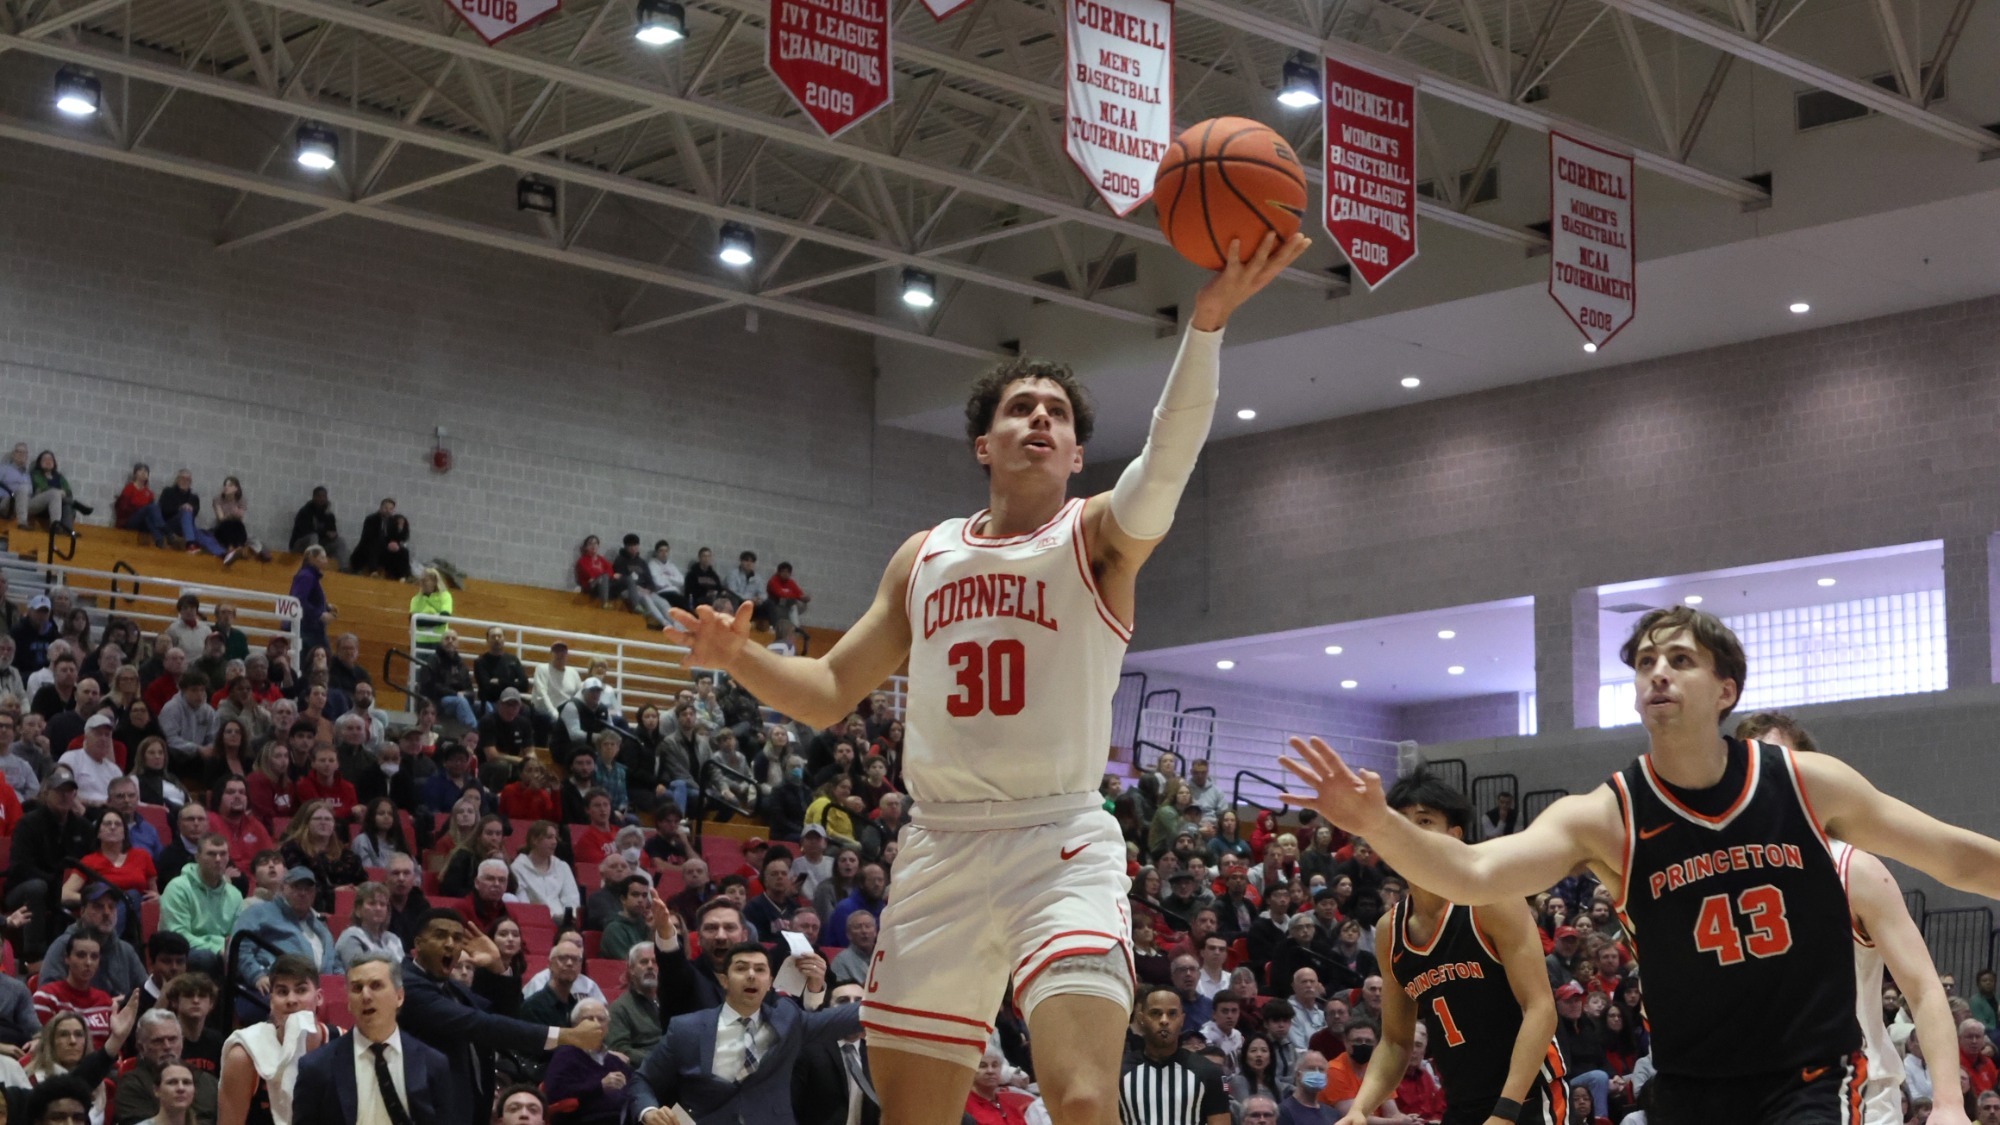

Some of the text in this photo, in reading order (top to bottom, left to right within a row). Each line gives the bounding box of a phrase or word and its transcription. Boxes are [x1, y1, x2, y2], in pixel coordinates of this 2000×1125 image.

[781, 2, 879, 49] IVY LEAGUE
[1075, 0, 1165, 50] CORNELL
[779, 29, 881, 87] CHAMPIONS
[1099, 48, 1140, 78] MEN'S
[805, 81, 854, 116] 2009
[1076, 63, 1161, 105] BASKETBALL
[1099, 100, 1138, 132] NCAA
[1331, 81, 1409, 128] CORNELL
[1341, 123, 1399, 158] WOMEN'S
[1101, 169, 1140, 198] 2009
[1330, 144, 1411, 186] BASKETBALL
[1557, 156, 1627, 200] CORNELL
[1333, 171, 1407, 209] IVY LEAGUE
[1330, 194, 1410, 241] CHAMPIONS
[1561, 214, 1627, 249] BASKETBALL
[1570, 198, 1618, 227] WOMEN'S
[1351, 238, 1389, 266] 2008
[1579, 246, 1609, 274] NCAA
[1555, 261, 1631, 301] TOURNAMENT
[1580, 306, 1612, 332] 2008
[278, 598, 299, 618] WC
[924, 573, 1058, 640] CORNELL
[946, 639, 1026, 718] 30
[1650, 842, 1804, 900] PRINCETON
[1693, 884, 1793, 966] 43
[1404, 961, 1485, 1001] RINCETON
[1432, 995, 1466, 1048] 1
